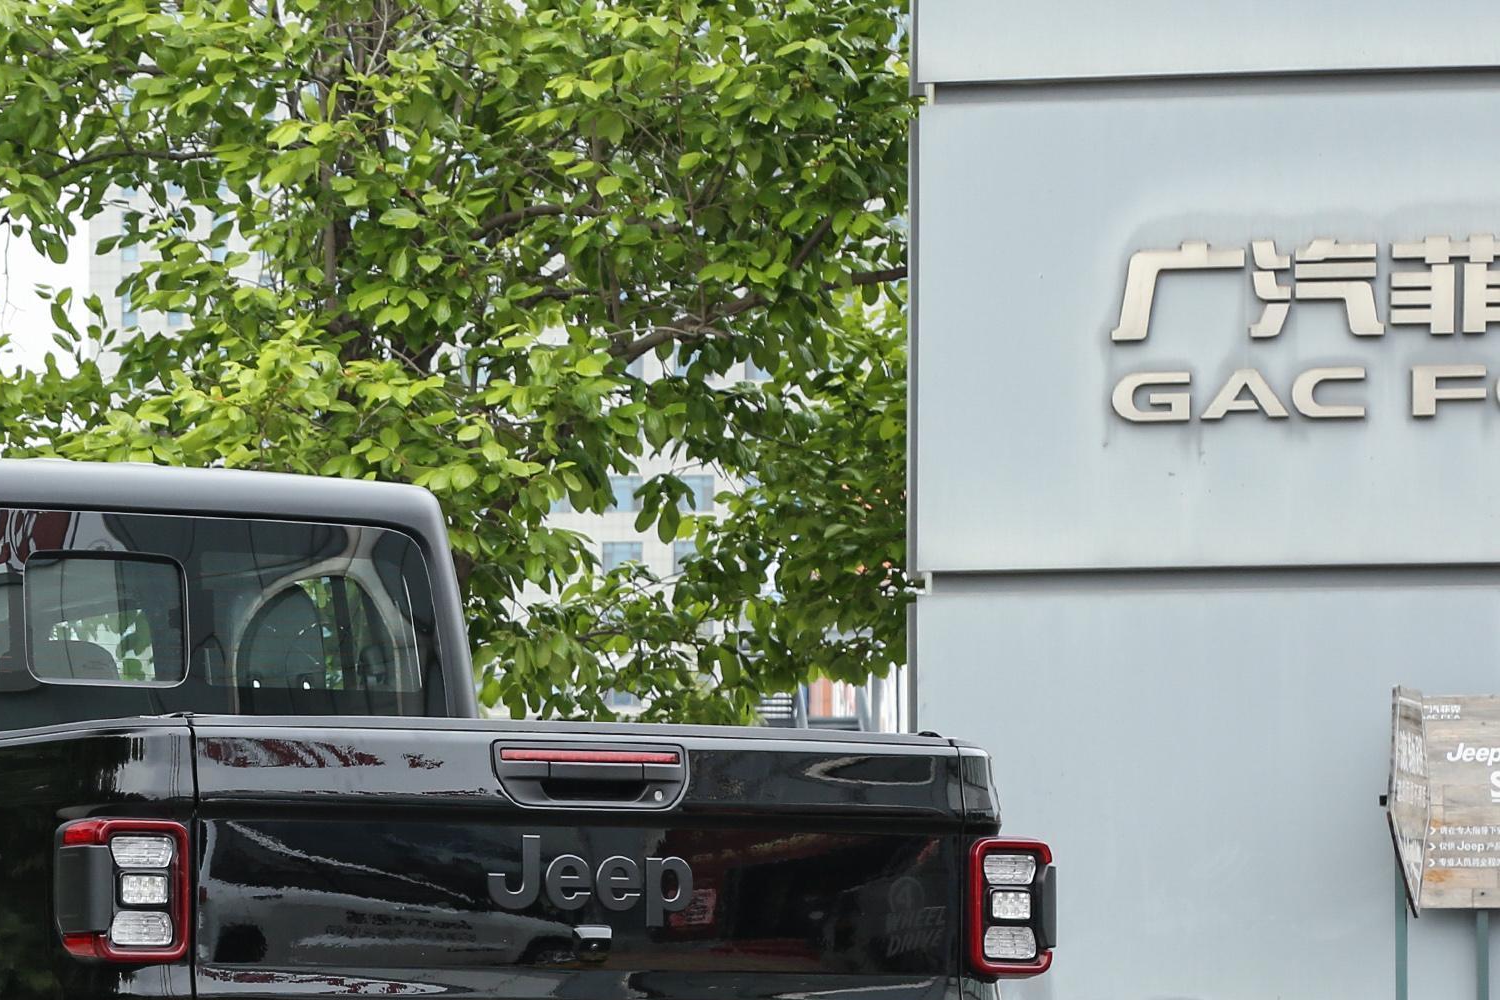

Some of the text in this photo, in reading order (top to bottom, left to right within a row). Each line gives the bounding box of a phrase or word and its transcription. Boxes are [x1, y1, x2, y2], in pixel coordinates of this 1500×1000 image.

[1112, 365, 1500, 422] GAC F
[1446, 742, 1500, 767] Jeep
[1457, 841, 1485, 852] Jeep
[487, 833, 693, 927] Jeep
